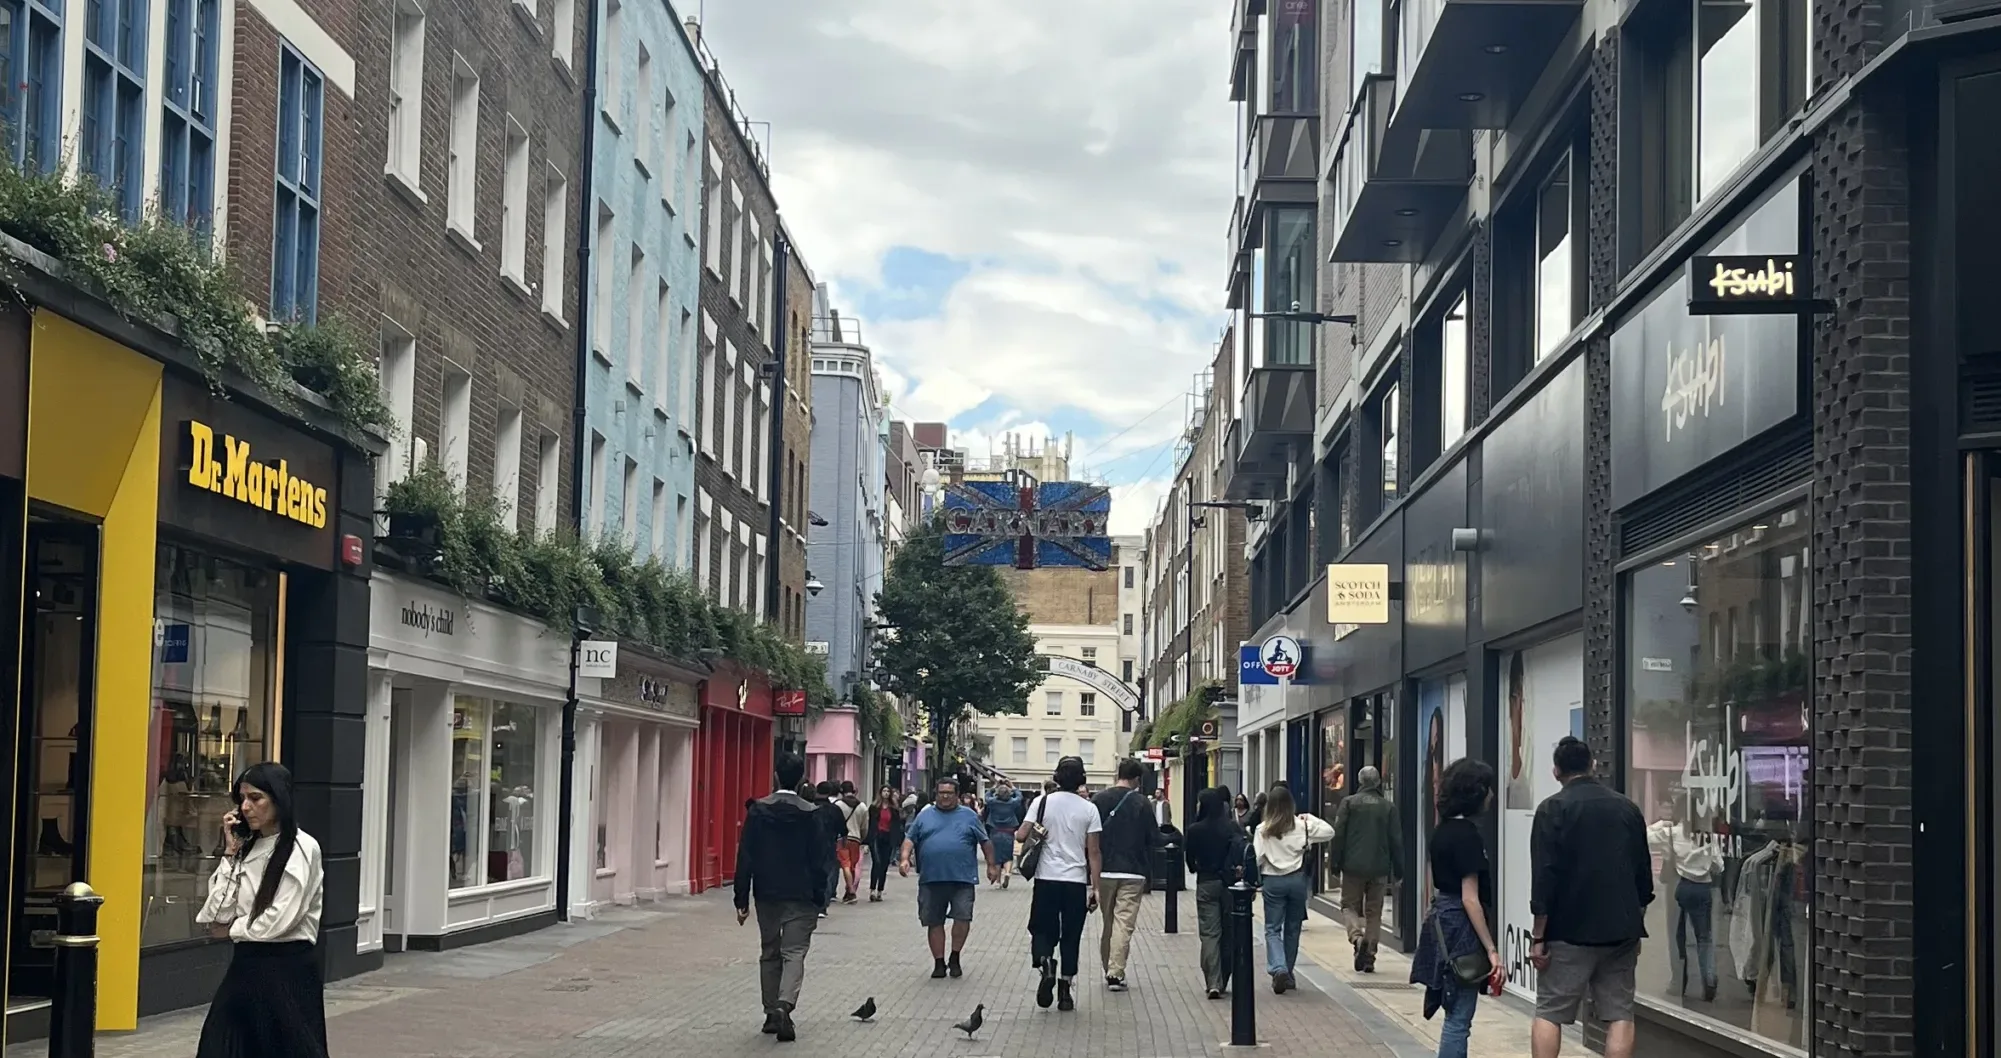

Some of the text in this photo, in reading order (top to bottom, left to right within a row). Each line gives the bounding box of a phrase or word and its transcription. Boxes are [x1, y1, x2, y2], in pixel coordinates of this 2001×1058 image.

[1709, 258, 1794, 297] ksubi
[1661, 315, 1725, 443] ksubi
[945, 506, 1109, 537] CARNABY
[1334, 581, 1381, 590] SCOTCH
[1349, 590, 1381, 600] SODA
[401, 600, 454, 639] nobody's child
[585, 648, 611, 663] nc
[1243, 661, 1264, 669] OFF
[1271, 665, 1291, 673] JOTT
[1058, 661, 1130, 703] CARNABY STREET
[1681, 704, 1747, 825] ksubi
